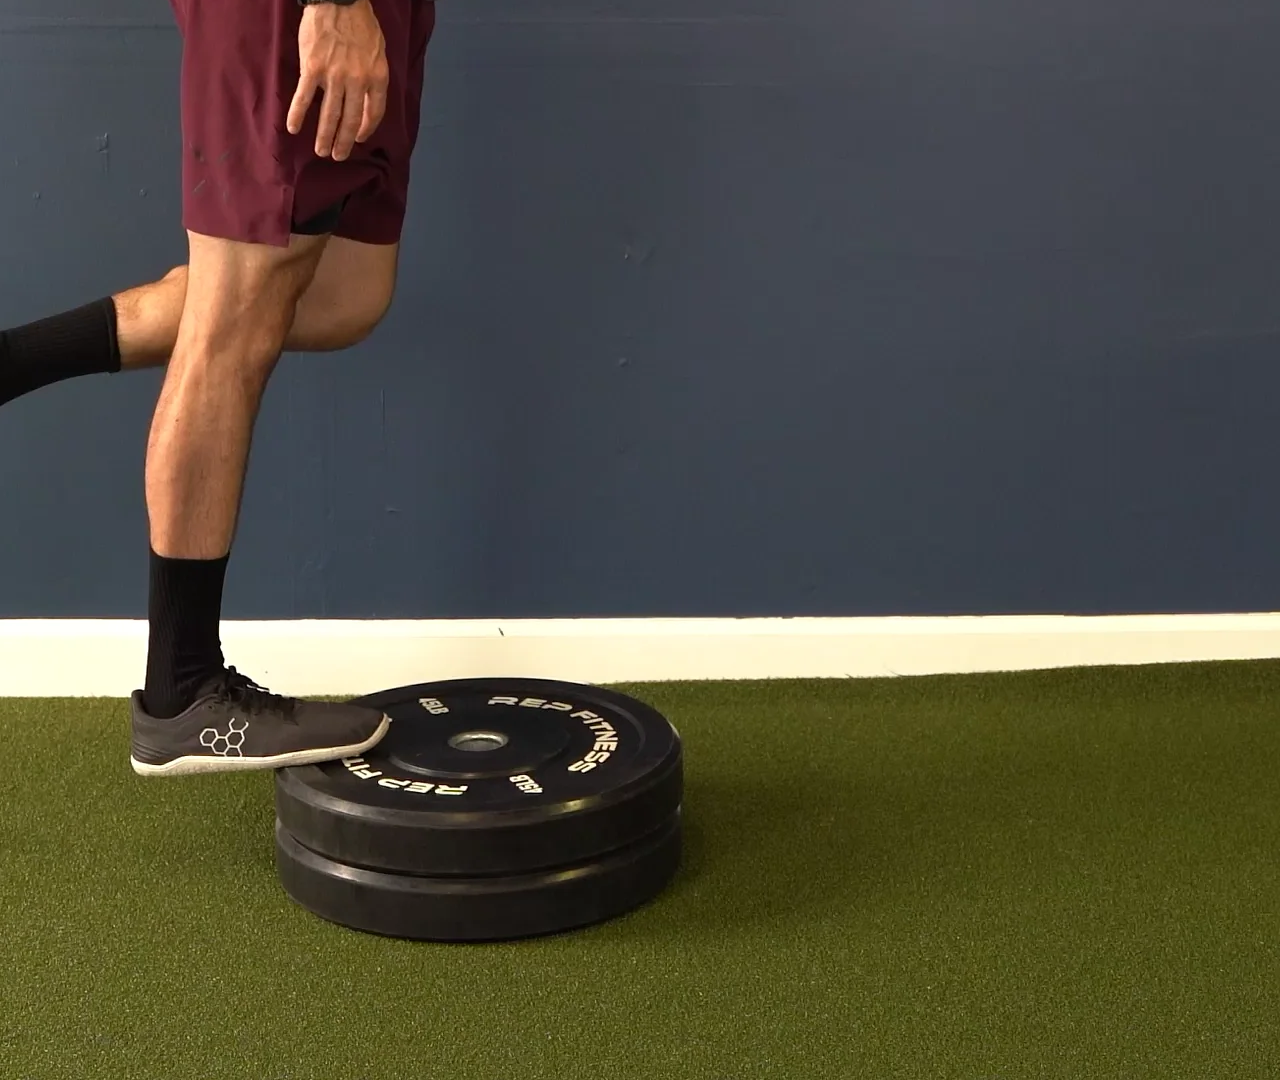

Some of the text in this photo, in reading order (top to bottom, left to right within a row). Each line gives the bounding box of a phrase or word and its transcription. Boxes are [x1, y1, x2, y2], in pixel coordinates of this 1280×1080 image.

[418, 697, 450, 716] 45LB
[487, 696, 619, 774] REP FITNESS
[377, 777, 469, 796] REP
[508, 773, 544, 795] 45LB
